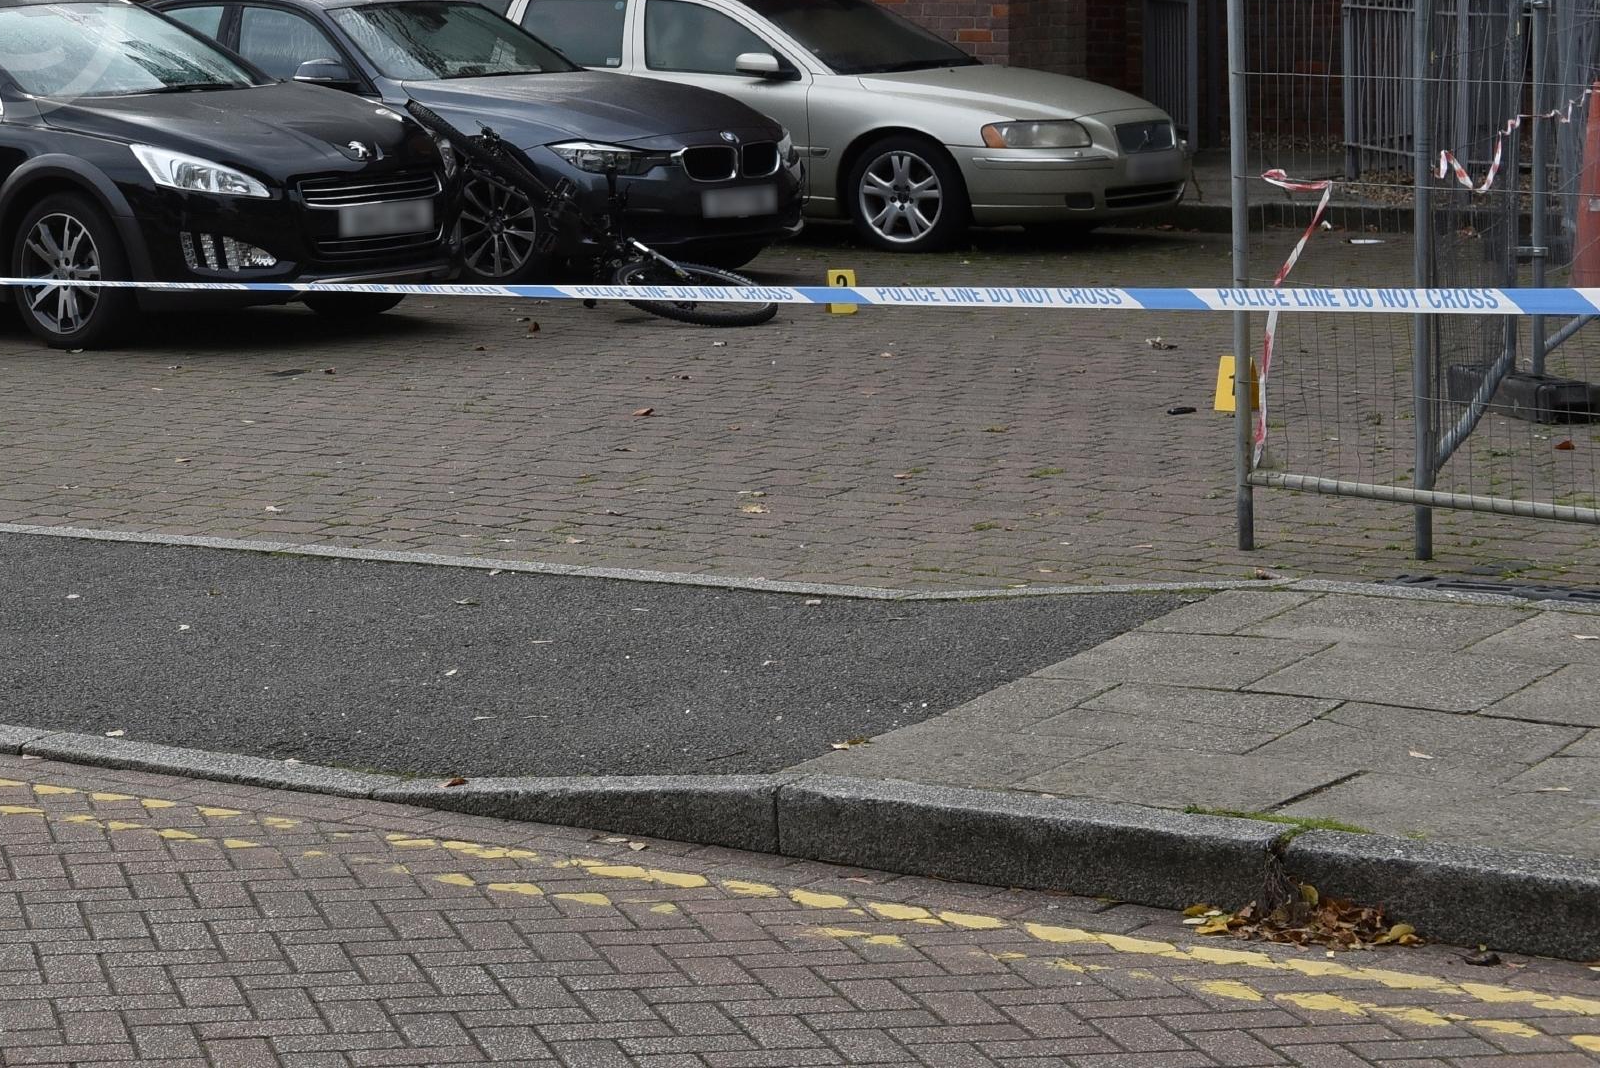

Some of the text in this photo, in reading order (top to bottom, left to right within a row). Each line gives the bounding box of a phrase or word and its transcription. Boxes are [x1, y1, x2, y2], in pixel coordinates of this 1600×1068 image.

[577, 286, 794, 301] POLICE LINE DO NOT CROSS
[878, 288, 1122, 305] POLICE LINE DO NOT CROSS
[1218, 289, 1499, 309] POLICE LINE DO NOT CROSS
